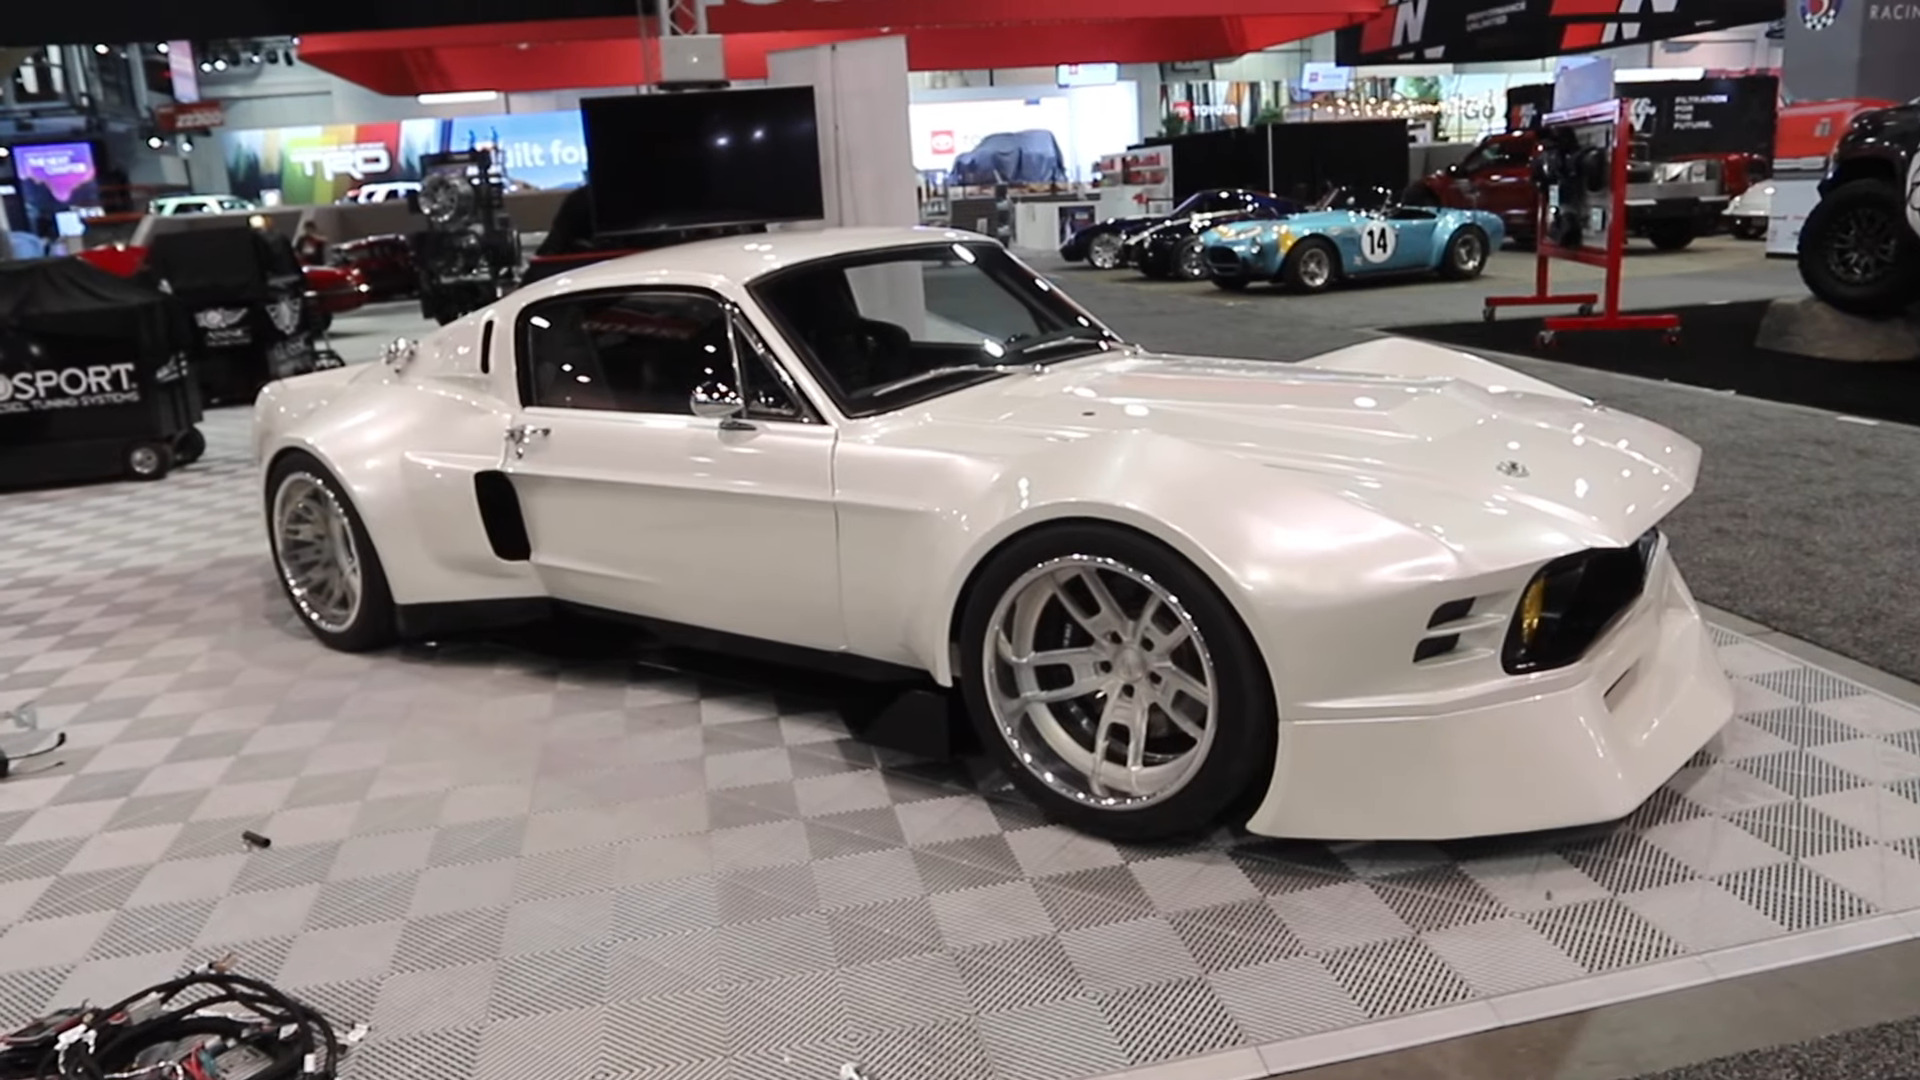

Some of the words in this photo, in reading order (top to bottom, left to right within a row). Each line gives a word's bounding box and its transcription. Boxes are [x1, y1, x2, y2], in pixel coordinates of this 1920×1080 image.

[1674, 94, 1728, 104] FILTRATION
[1193, 103, 1238, 117] TOYOTA
[289, 147, 392, 183] TRD
[1367, 226, 1388, 255] 14
